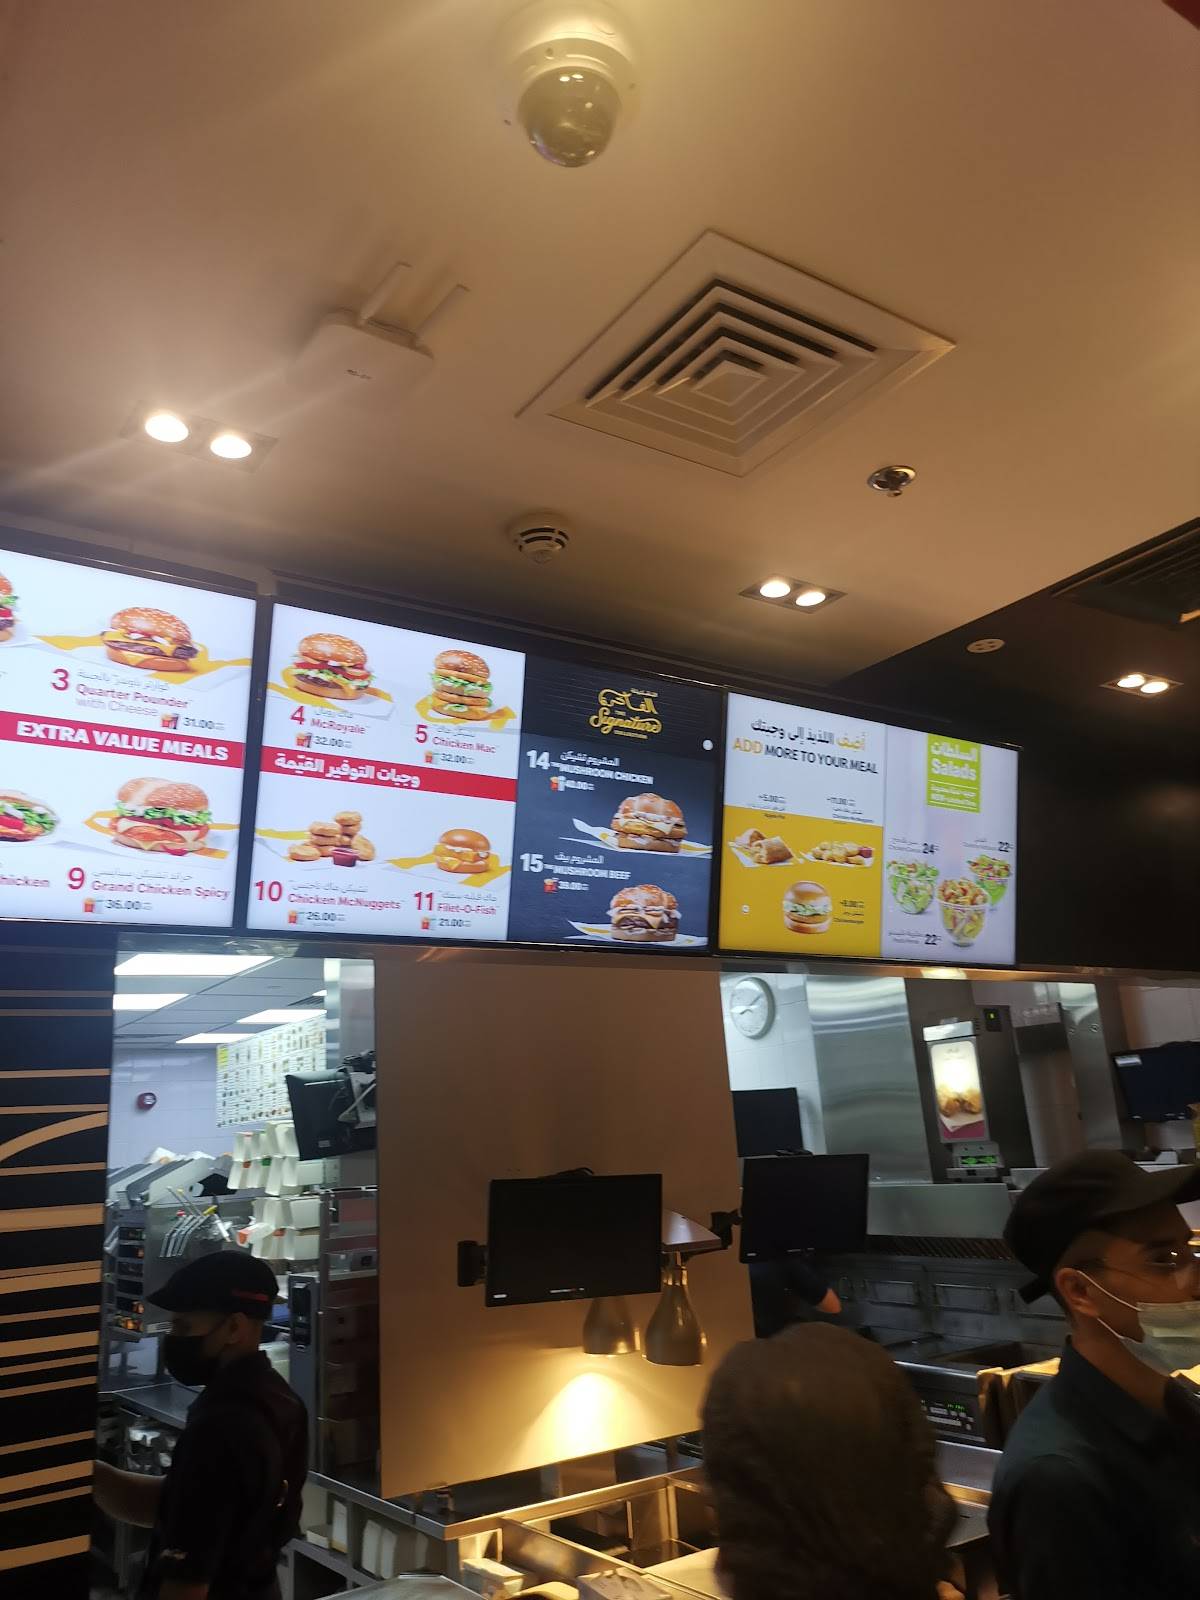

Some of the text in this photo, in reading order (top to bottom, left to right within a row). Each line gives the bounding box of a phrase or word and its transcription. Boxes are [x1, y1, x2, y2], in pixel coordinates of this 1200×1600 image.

[51, 668, 69, 691] 3
[76, 683, 188, 709] Quarter Pounder
[108, 701, 158, 717] Cheese
[290, 705, 305, 725] 4
[311, 719, 365, 735] McRoyale
[589, 707, 662, 734] Signature
[751, 718, 785, 740] وجبتك
[17, 721, 229, 761] EXTRA VALUE MEALS
[415, 724, 428, 744] 5
[432, 736, 497, 754] Chicken Mac
[526, 749, 550, 770] 14
[733, 737, 878, 775] ADD MORE TO YOUR MEAL
[274, 752, 421, 789] وجبات التوفير القيمة
[931, 758, 977, 781] Salads
[520, 853, 544, 873] 15
[0, 873, 49, 888] hicken
[67, 867, 85, 890] 9
[608, 870, 632, 880] BEEF
[91, 881, 229, 900] Grand Chicken Spicy
[255, 880, 283, 902] 10
[288, 893, 401, 911] Chicken McNuggets
[414, 891, 434, 911] 11
[437, 901, 497, 916] Filet-O-Fish
[924, 933, 937, 946] 22
